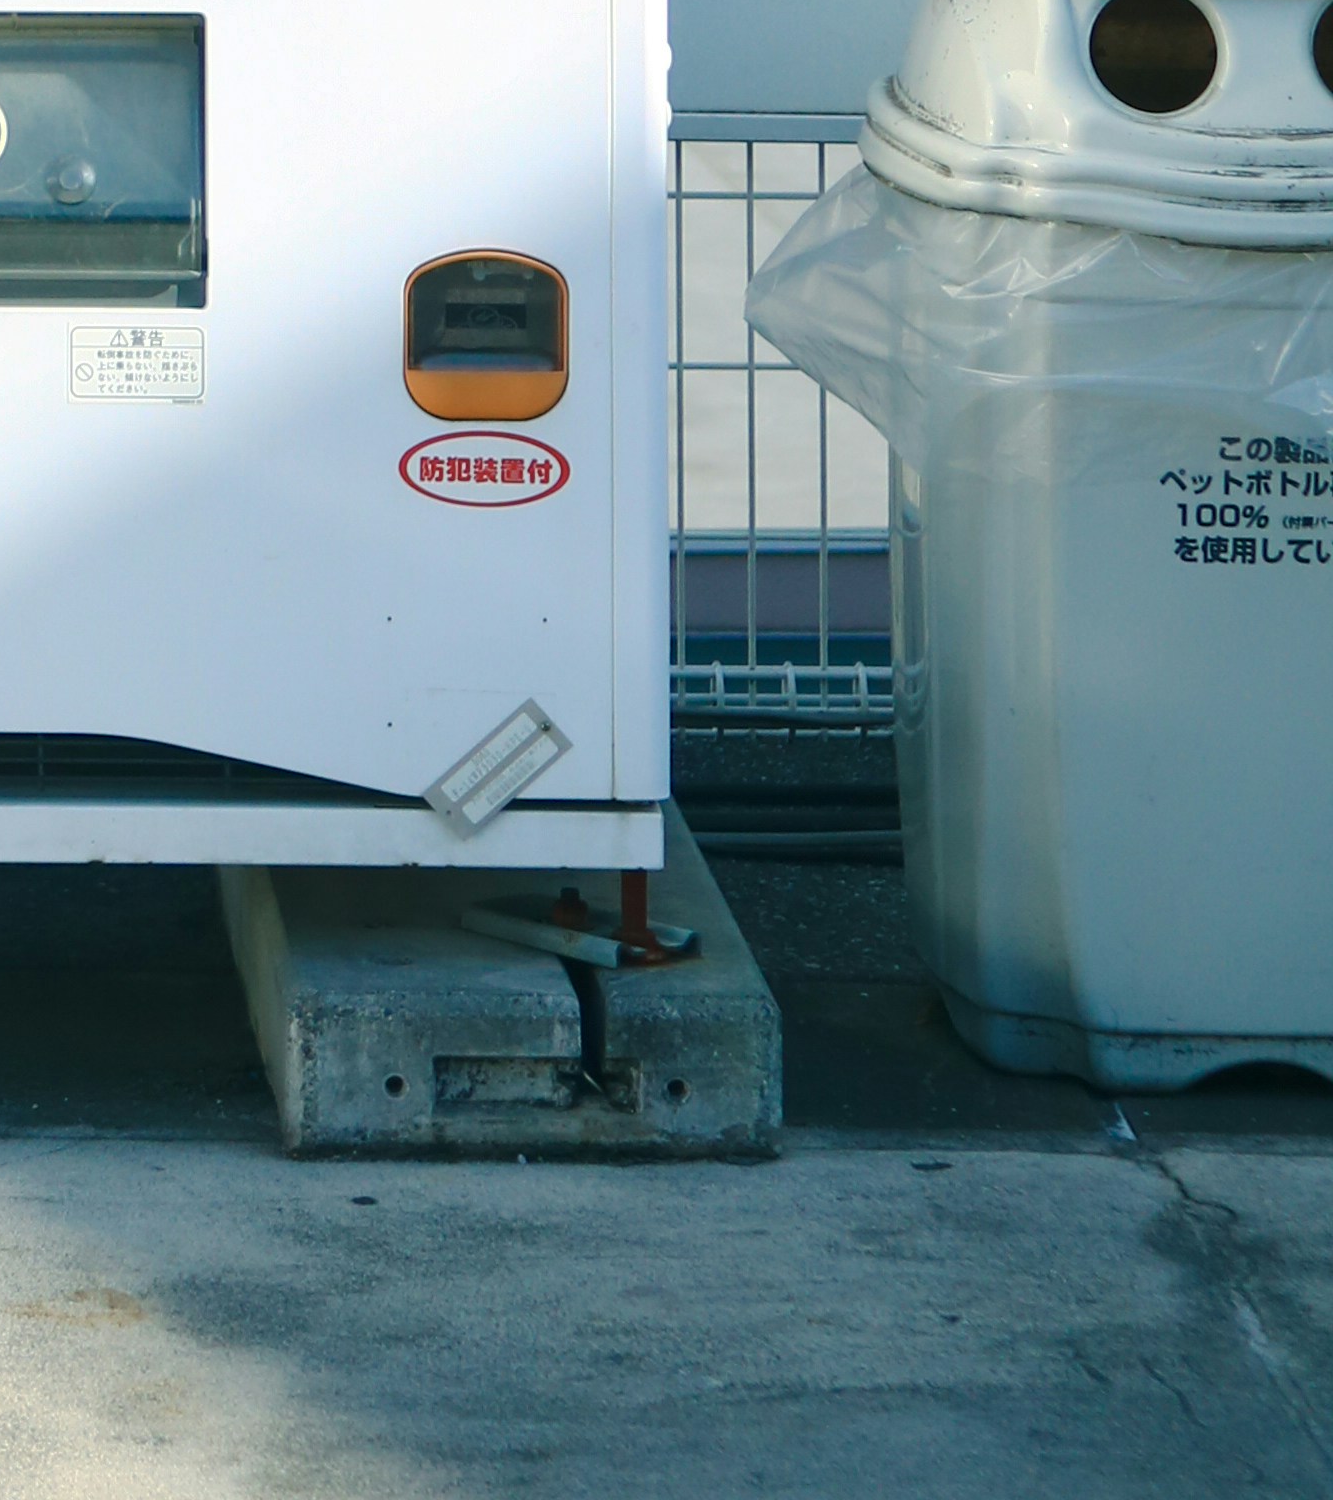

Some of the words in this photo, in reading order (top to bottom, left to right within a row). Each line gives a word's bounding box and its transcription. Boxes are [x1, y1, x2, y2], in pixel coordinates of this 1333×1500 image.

[130, 330, 165, 347] 警告
[98, 384, 148, 394] てください。
[419, 456, 554, 485] 防犯装置付
[1160, 469, 1333, 497] ペットボトル
[1177, 503, 1269, 529] 100%
